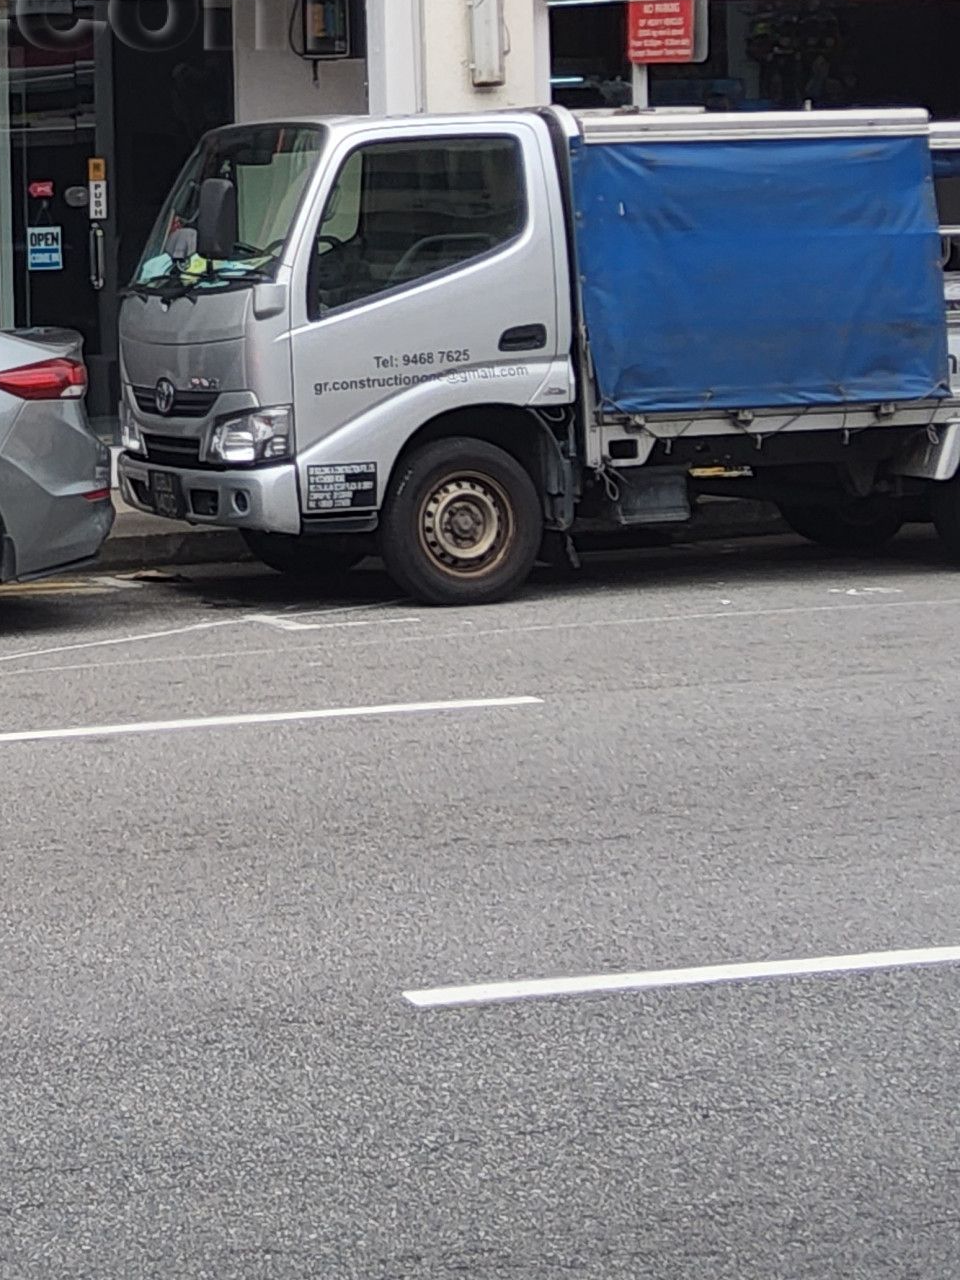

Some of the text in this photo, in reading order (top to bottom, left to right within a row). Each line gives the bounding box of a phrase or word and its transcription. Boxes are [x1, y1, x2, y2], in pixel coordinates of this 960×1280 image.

[94, 183, 103, 216] PUSH
[30, 232, 60, 247] OPEN
[374, 349, 470, 369] Tel: 9468 7625
